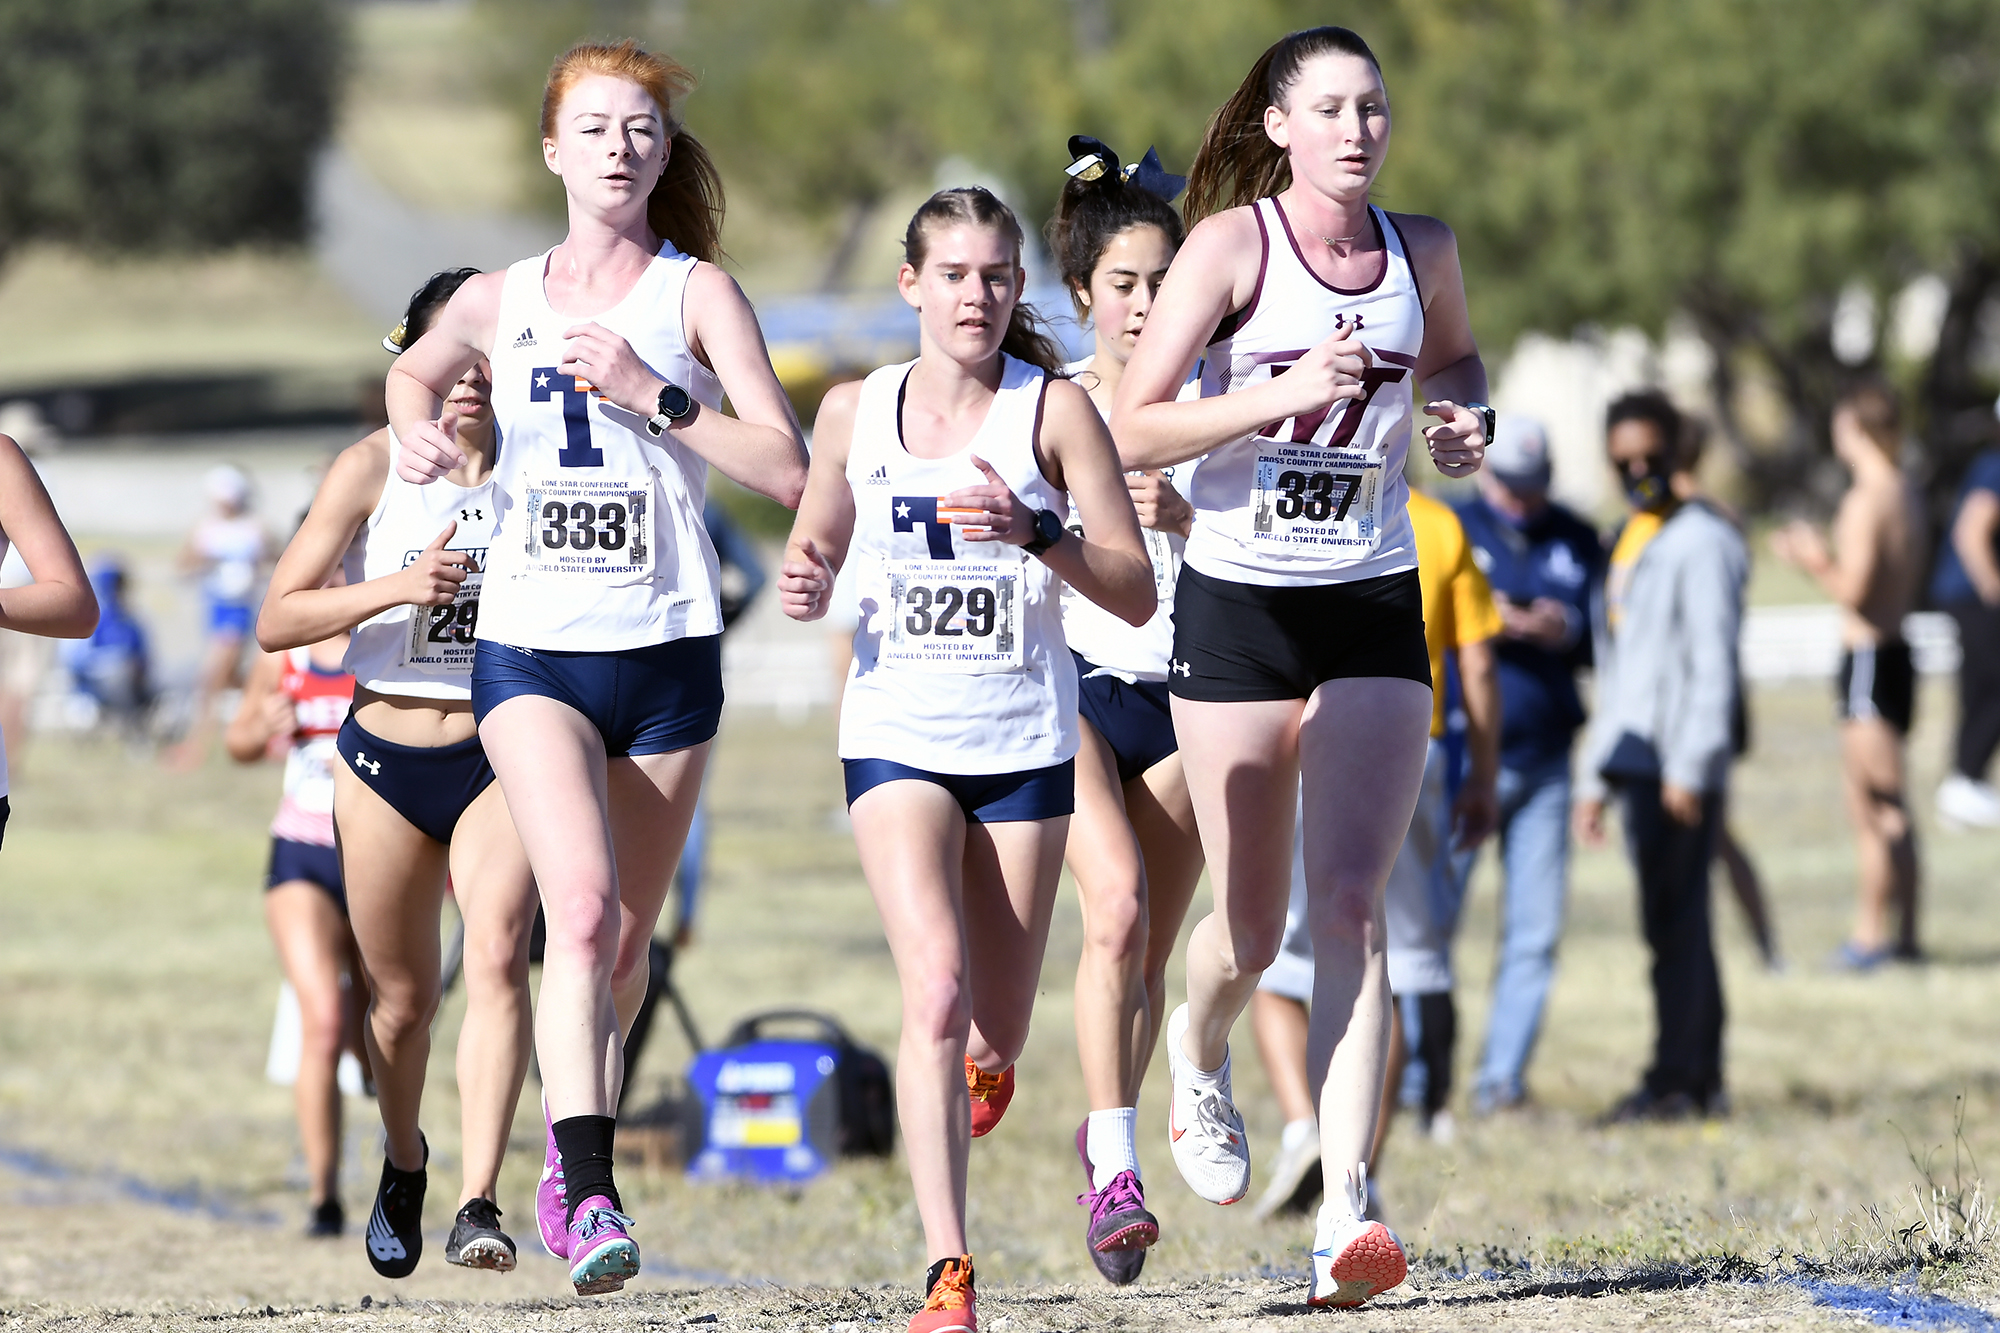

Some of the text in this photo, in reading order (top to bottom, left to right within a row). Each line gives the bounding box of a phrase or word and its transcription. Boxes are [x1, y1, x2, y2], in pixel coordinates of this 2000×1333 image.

[513, 339, 538, 349] adidas
[1278, 448, 1368, 461] LONE STAR CONFERENCE
[1258, 455, 1382, 470] CROSS COUNTRY CHAMPIONSHIPS
[580, 481, 629, 489] CONFERENCE
[525, 488, 648, 497] CROSS COUNTRY CHAMPIONSHIPS
[1276, 470, 1363, 522] 337
[542, 501, 627, 551] 333
[1292, 526, 1339, 536] HOSTED BY
[1254, 532, 1373, 547] ANGELO STATE UNIVERSITY
[559, 556, 593, 564] HOSTED
[525, 564, 644, 574] ANGELO STATE UNIVERSITY
[905, 586, 996, 637] 329
[427, 600, 479, 644] 29
[443, 648, 475, 656] HOSTED
[923, 643, 975, 651] HOSTED BY
[410, 656, 442, 664] ANGELO
[887, 652, 922, 660] ANGELO
[955, 653, 1013, 661] UNIVERSITY
